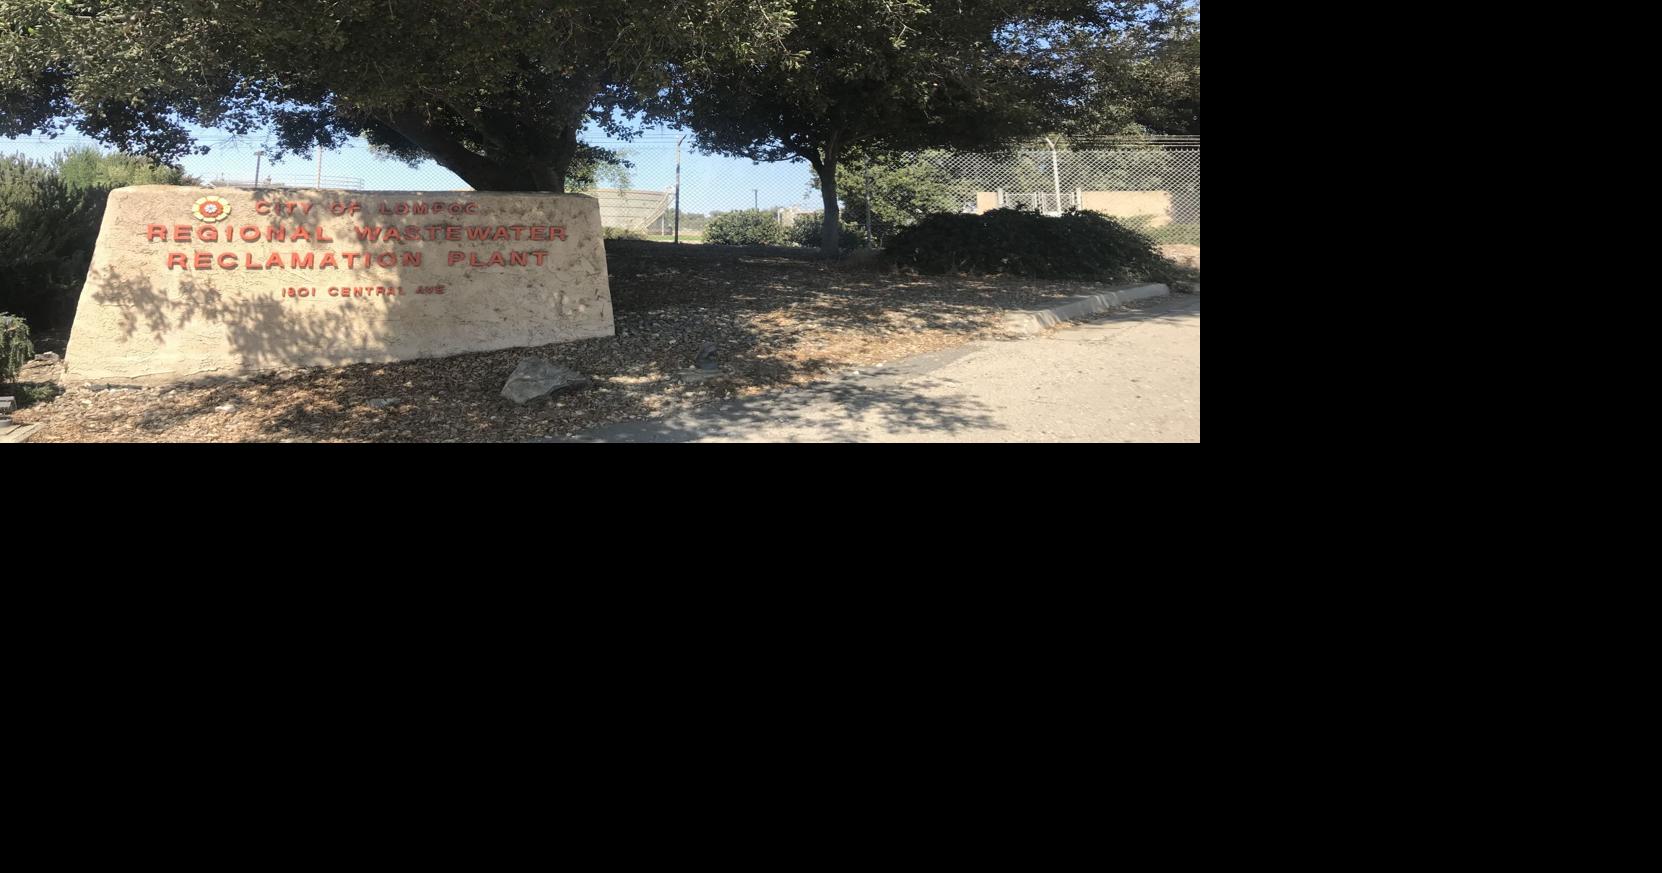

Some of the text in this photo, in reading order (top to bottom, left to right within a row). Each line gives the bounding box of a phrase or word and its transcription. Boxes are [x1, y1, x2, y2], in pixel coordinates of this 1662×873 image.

[256, 200, 479, 216] CITY OF LOMPOC
[147, 223, 568, 242] REGIONAL WASTEWATER
[167, 250, 549, 270] RECLAMATION PLANT
[282, 285, 446, 298] 1801 CENTRAL AVE
